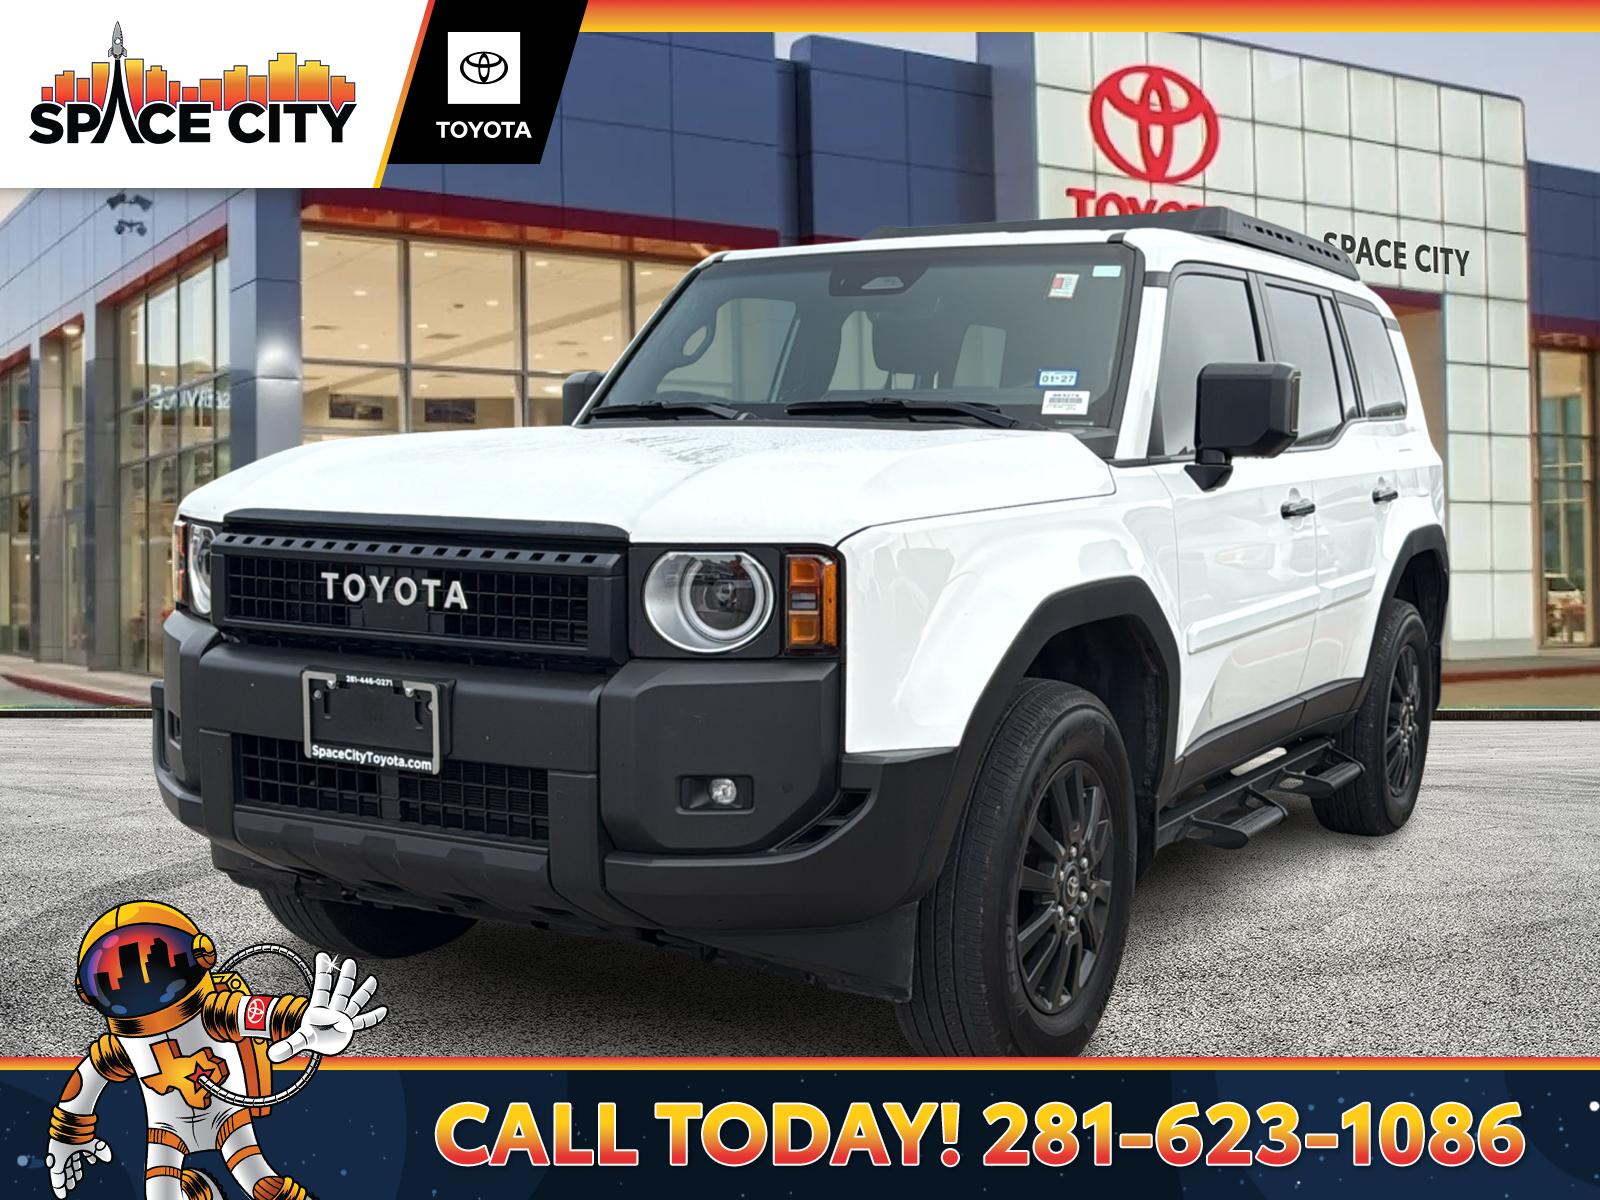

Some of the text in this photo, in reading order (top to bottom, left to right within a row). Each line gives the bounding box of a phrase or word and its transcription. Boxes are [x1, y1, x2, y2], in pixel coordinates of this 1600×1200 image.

[1066, 187, 1206, 218] TOY
[1414, 244, 1470, 277] CITY
[321, 571, 469, 610] TOYOTA
[311, 744, 432, 771] SpaceCityToyota.com
